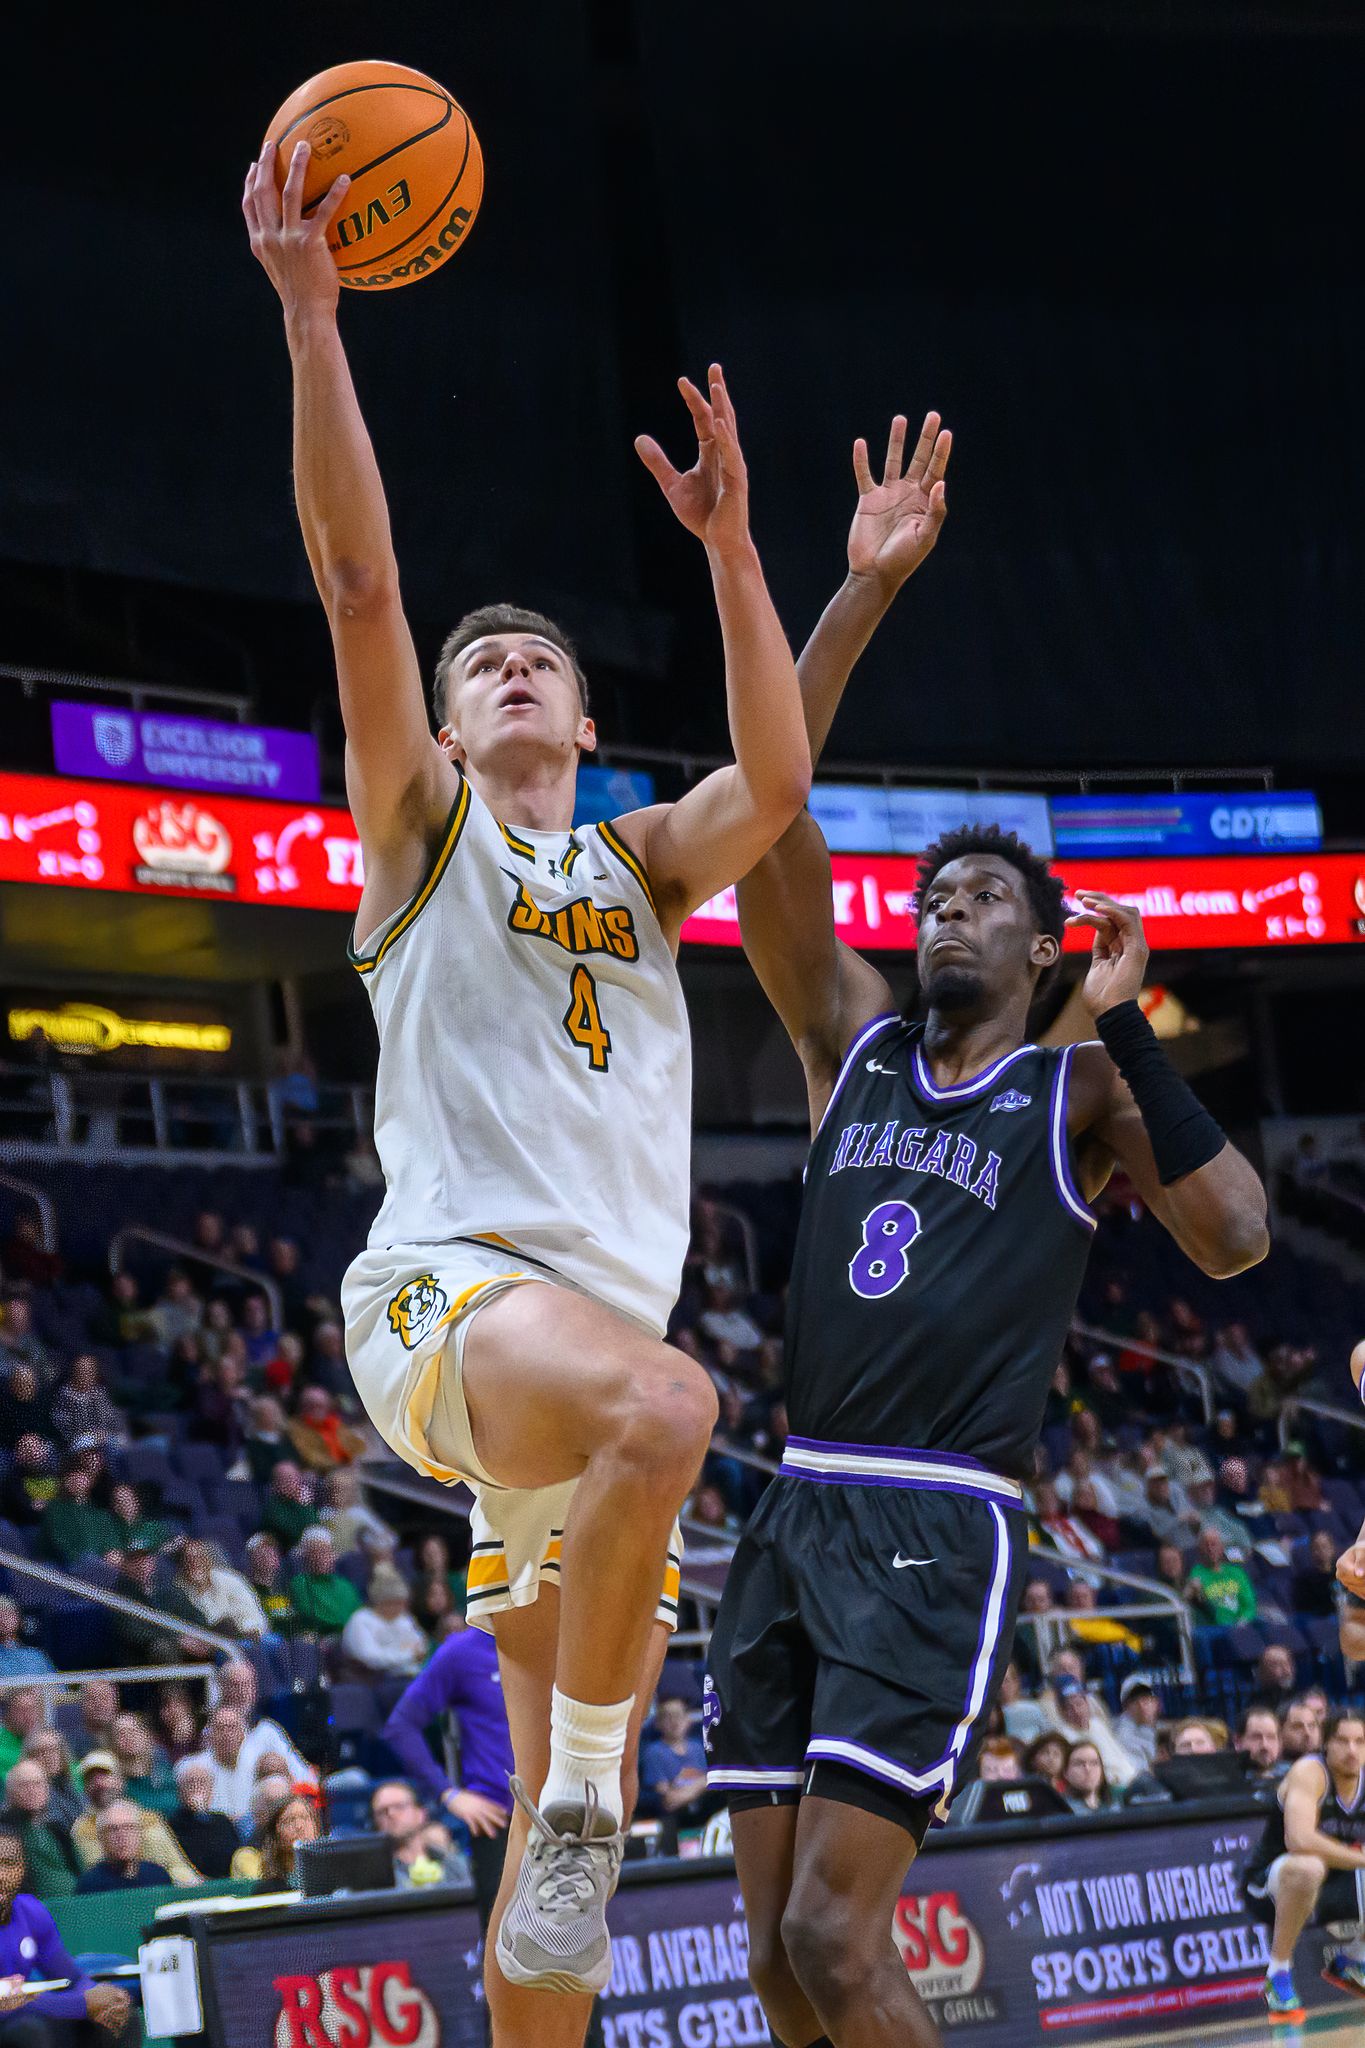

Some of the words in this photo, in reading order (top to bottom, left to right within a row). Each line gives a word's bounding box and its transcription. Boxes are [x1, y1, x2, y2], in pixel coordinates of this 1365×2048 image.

[337, 178, 412, 248] EVO
[562, 963, 612, 1073] 4
[829, 1120, 1002, 1210] NIAGARA
[848, 1200, 922, 1299] 8
[895, 1891, 969, 1970] SG
[1035, 1880, 1084, 1937] NOT
[1082, 1872, 1147, 1931] YOUR
[1146, 1860, 1244, 1924] AVERAGE
[600, 1935, 648, 1999] UR
[648, 1920, 749, 1992] AVERAG
[1031, 1937, 1170, 1999] SPORTS
[272, 1960, 424, 2048] RSG
[677, 1994, 772, 2048] GRI
[943, 1996, 997, 2025] GRILL
